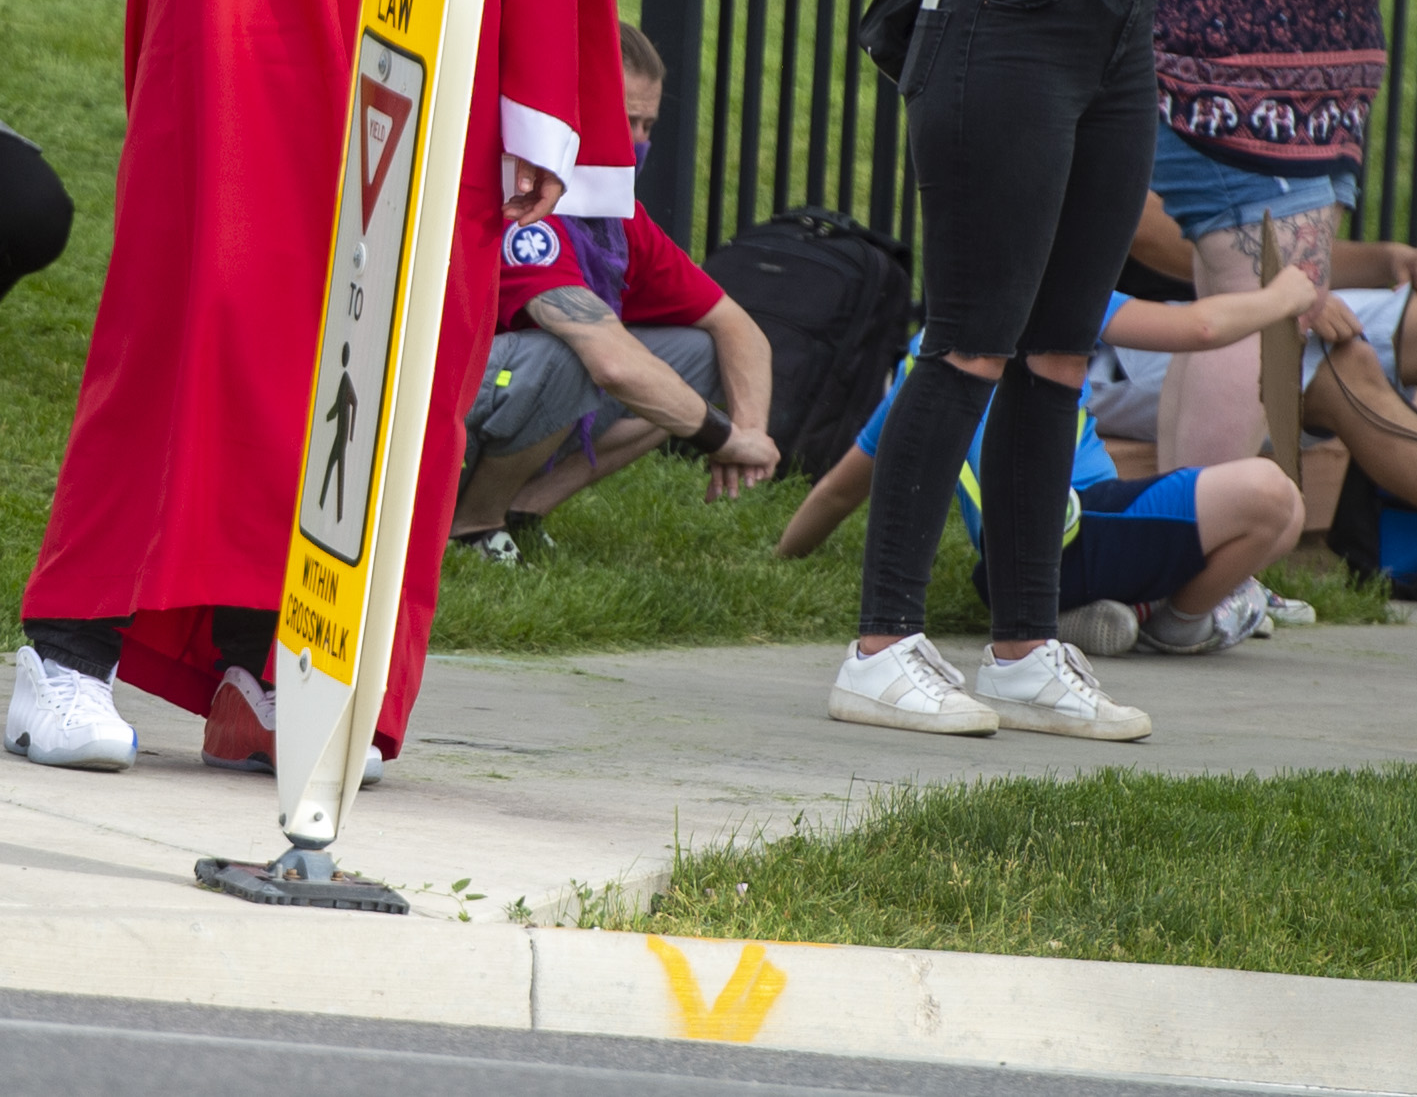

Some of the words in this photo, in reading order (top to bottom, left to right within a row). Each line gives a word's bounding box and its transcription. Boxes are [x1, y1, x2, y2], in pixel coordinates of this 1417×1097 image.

[369, 118, 386, 144] YIELD
[347, 281, 364, 322] TO
[303, 555, 339, 605] WITHIN
[286, 593, 349, 662] CROSSWALK
